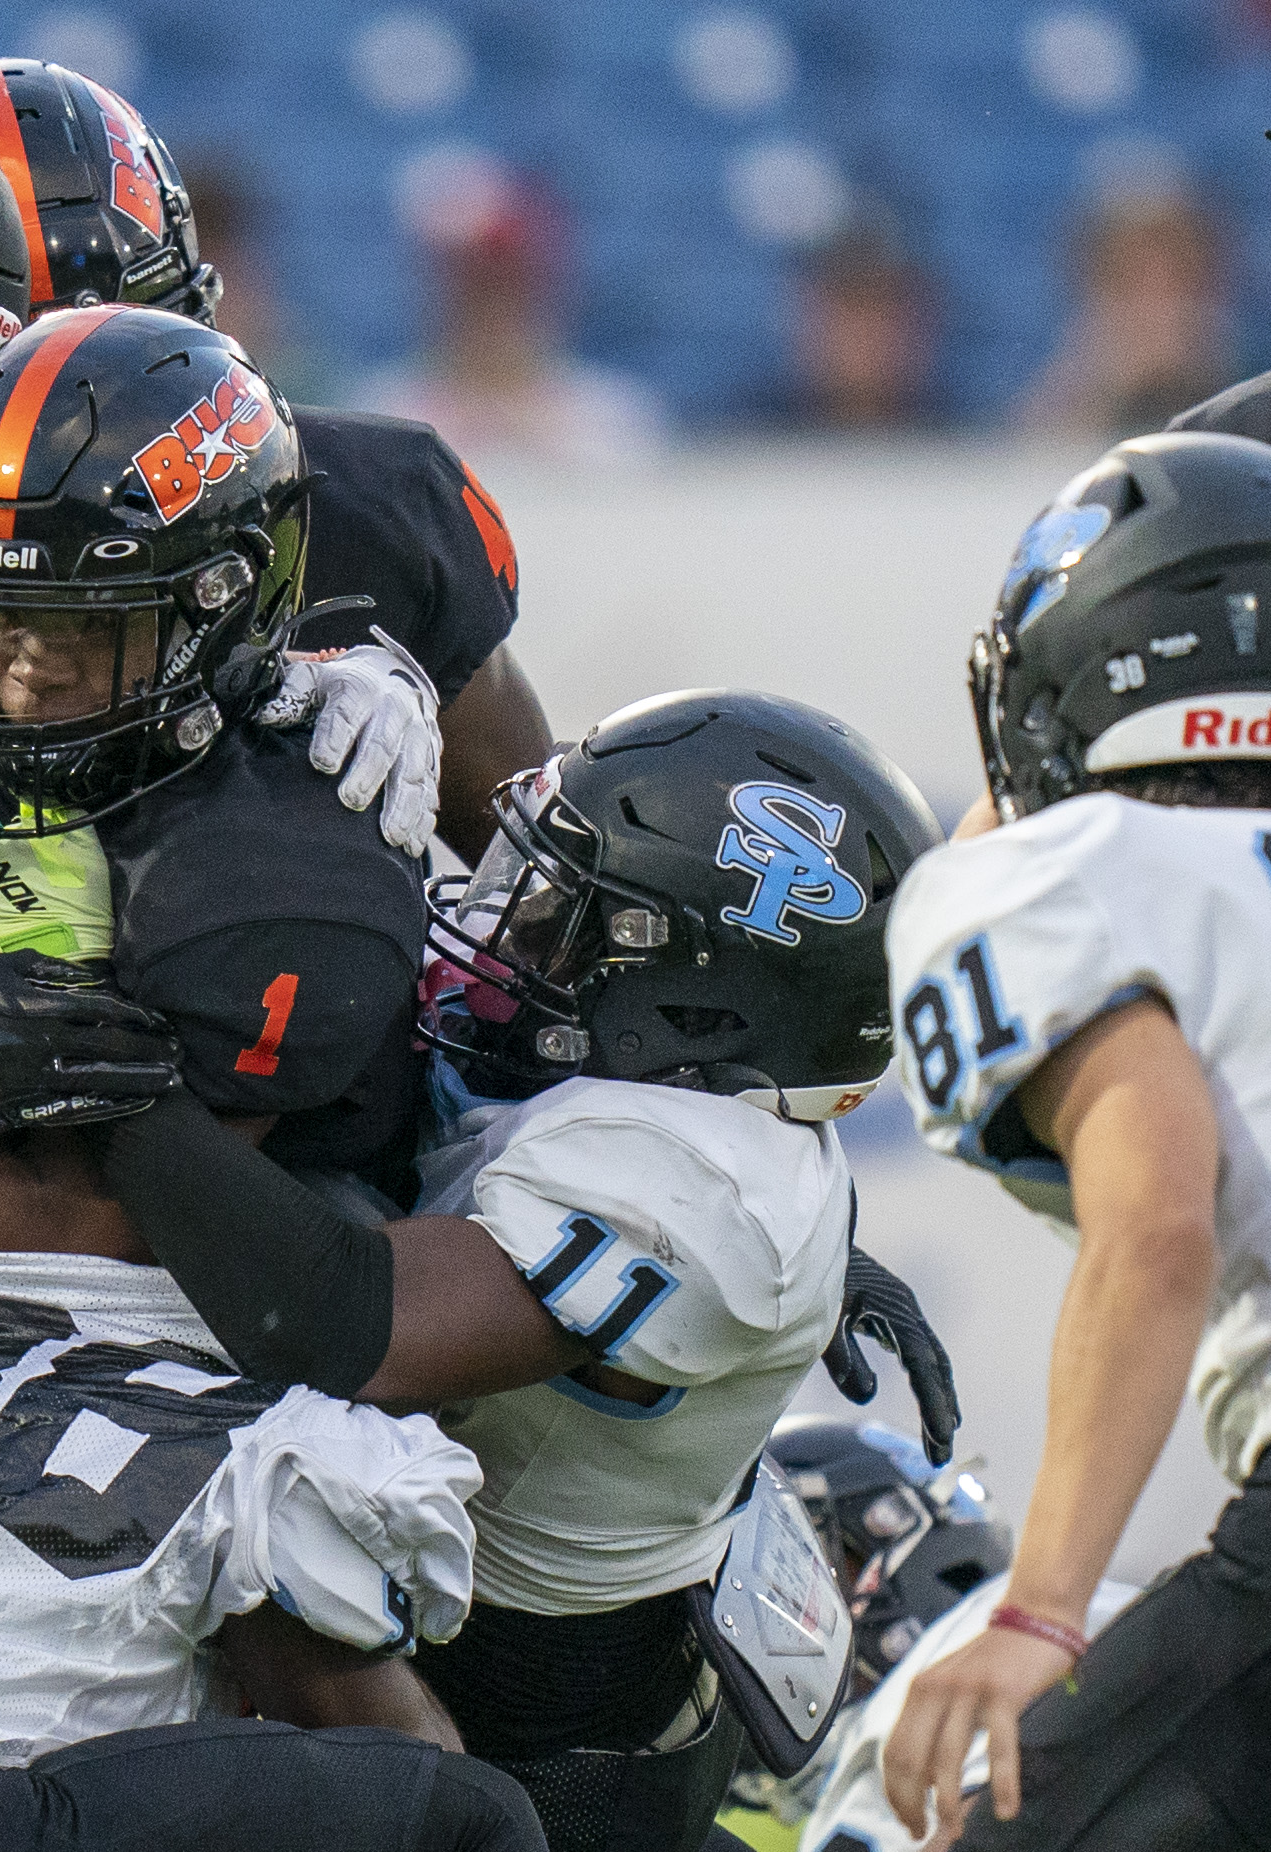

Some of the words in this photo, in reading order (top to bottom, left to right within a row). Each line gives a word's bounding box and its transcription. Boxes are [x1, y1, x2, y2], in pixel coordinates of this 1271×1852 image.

[126, 254, 173, 285] barnett
[234, 972, 299, 1075] 1
[901, 932, 1032, 1116] 81
[518, 1209, 683, 1365] 11
